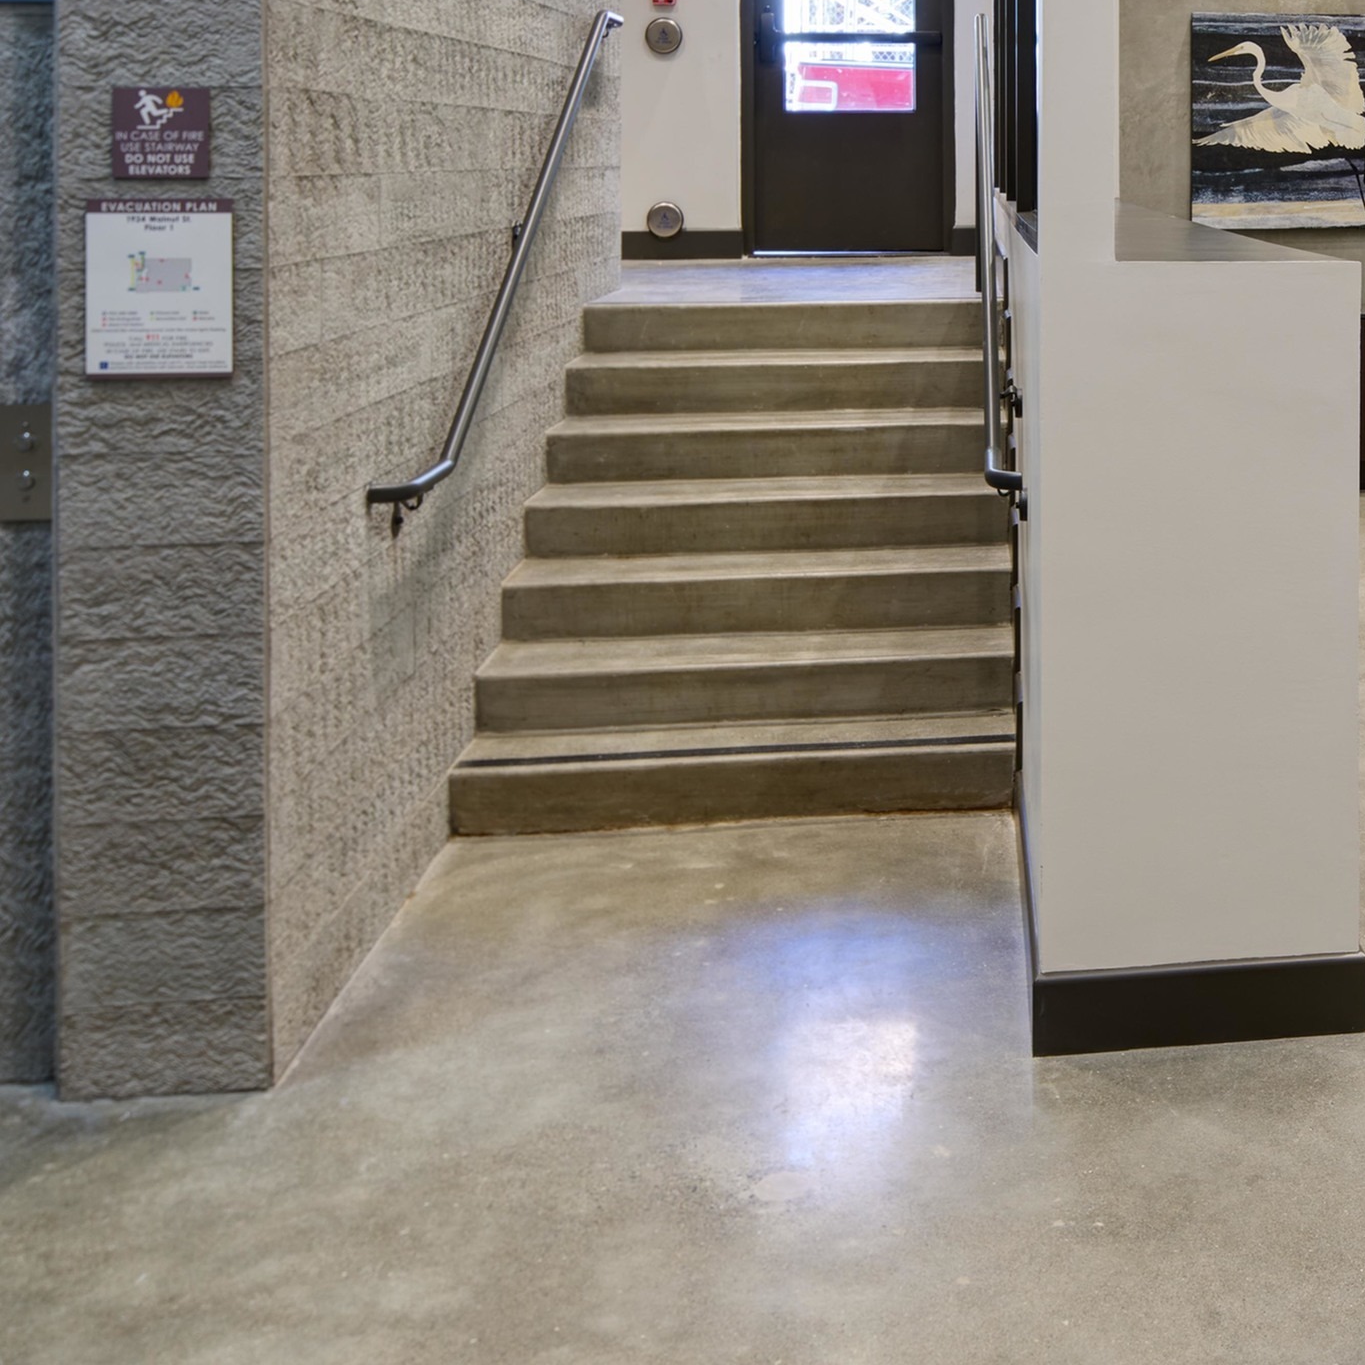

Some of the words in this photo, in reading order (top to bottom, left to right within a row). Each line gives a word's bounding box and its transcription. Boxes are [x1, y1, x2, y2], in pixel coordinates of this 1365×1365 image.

[114, 130, 128, 141] IN
[130, 130, 160, 141] CASE
[163, 130, 179, 141] OF
[182, 130, 204, 141] FIRE
[120, 142, 141, 153] USE
[144, 142, 200, 152] STAIRWAY
[124, 153, 144, 164] DO
[146, 153, 172, 164] NOT
[174, 153, 195, 164] USE
[128, 164, 191, 175] ELEVATORS
[100, 201, 181, 212] EVACUATION
[185, 201, 217, 212] PLAN
